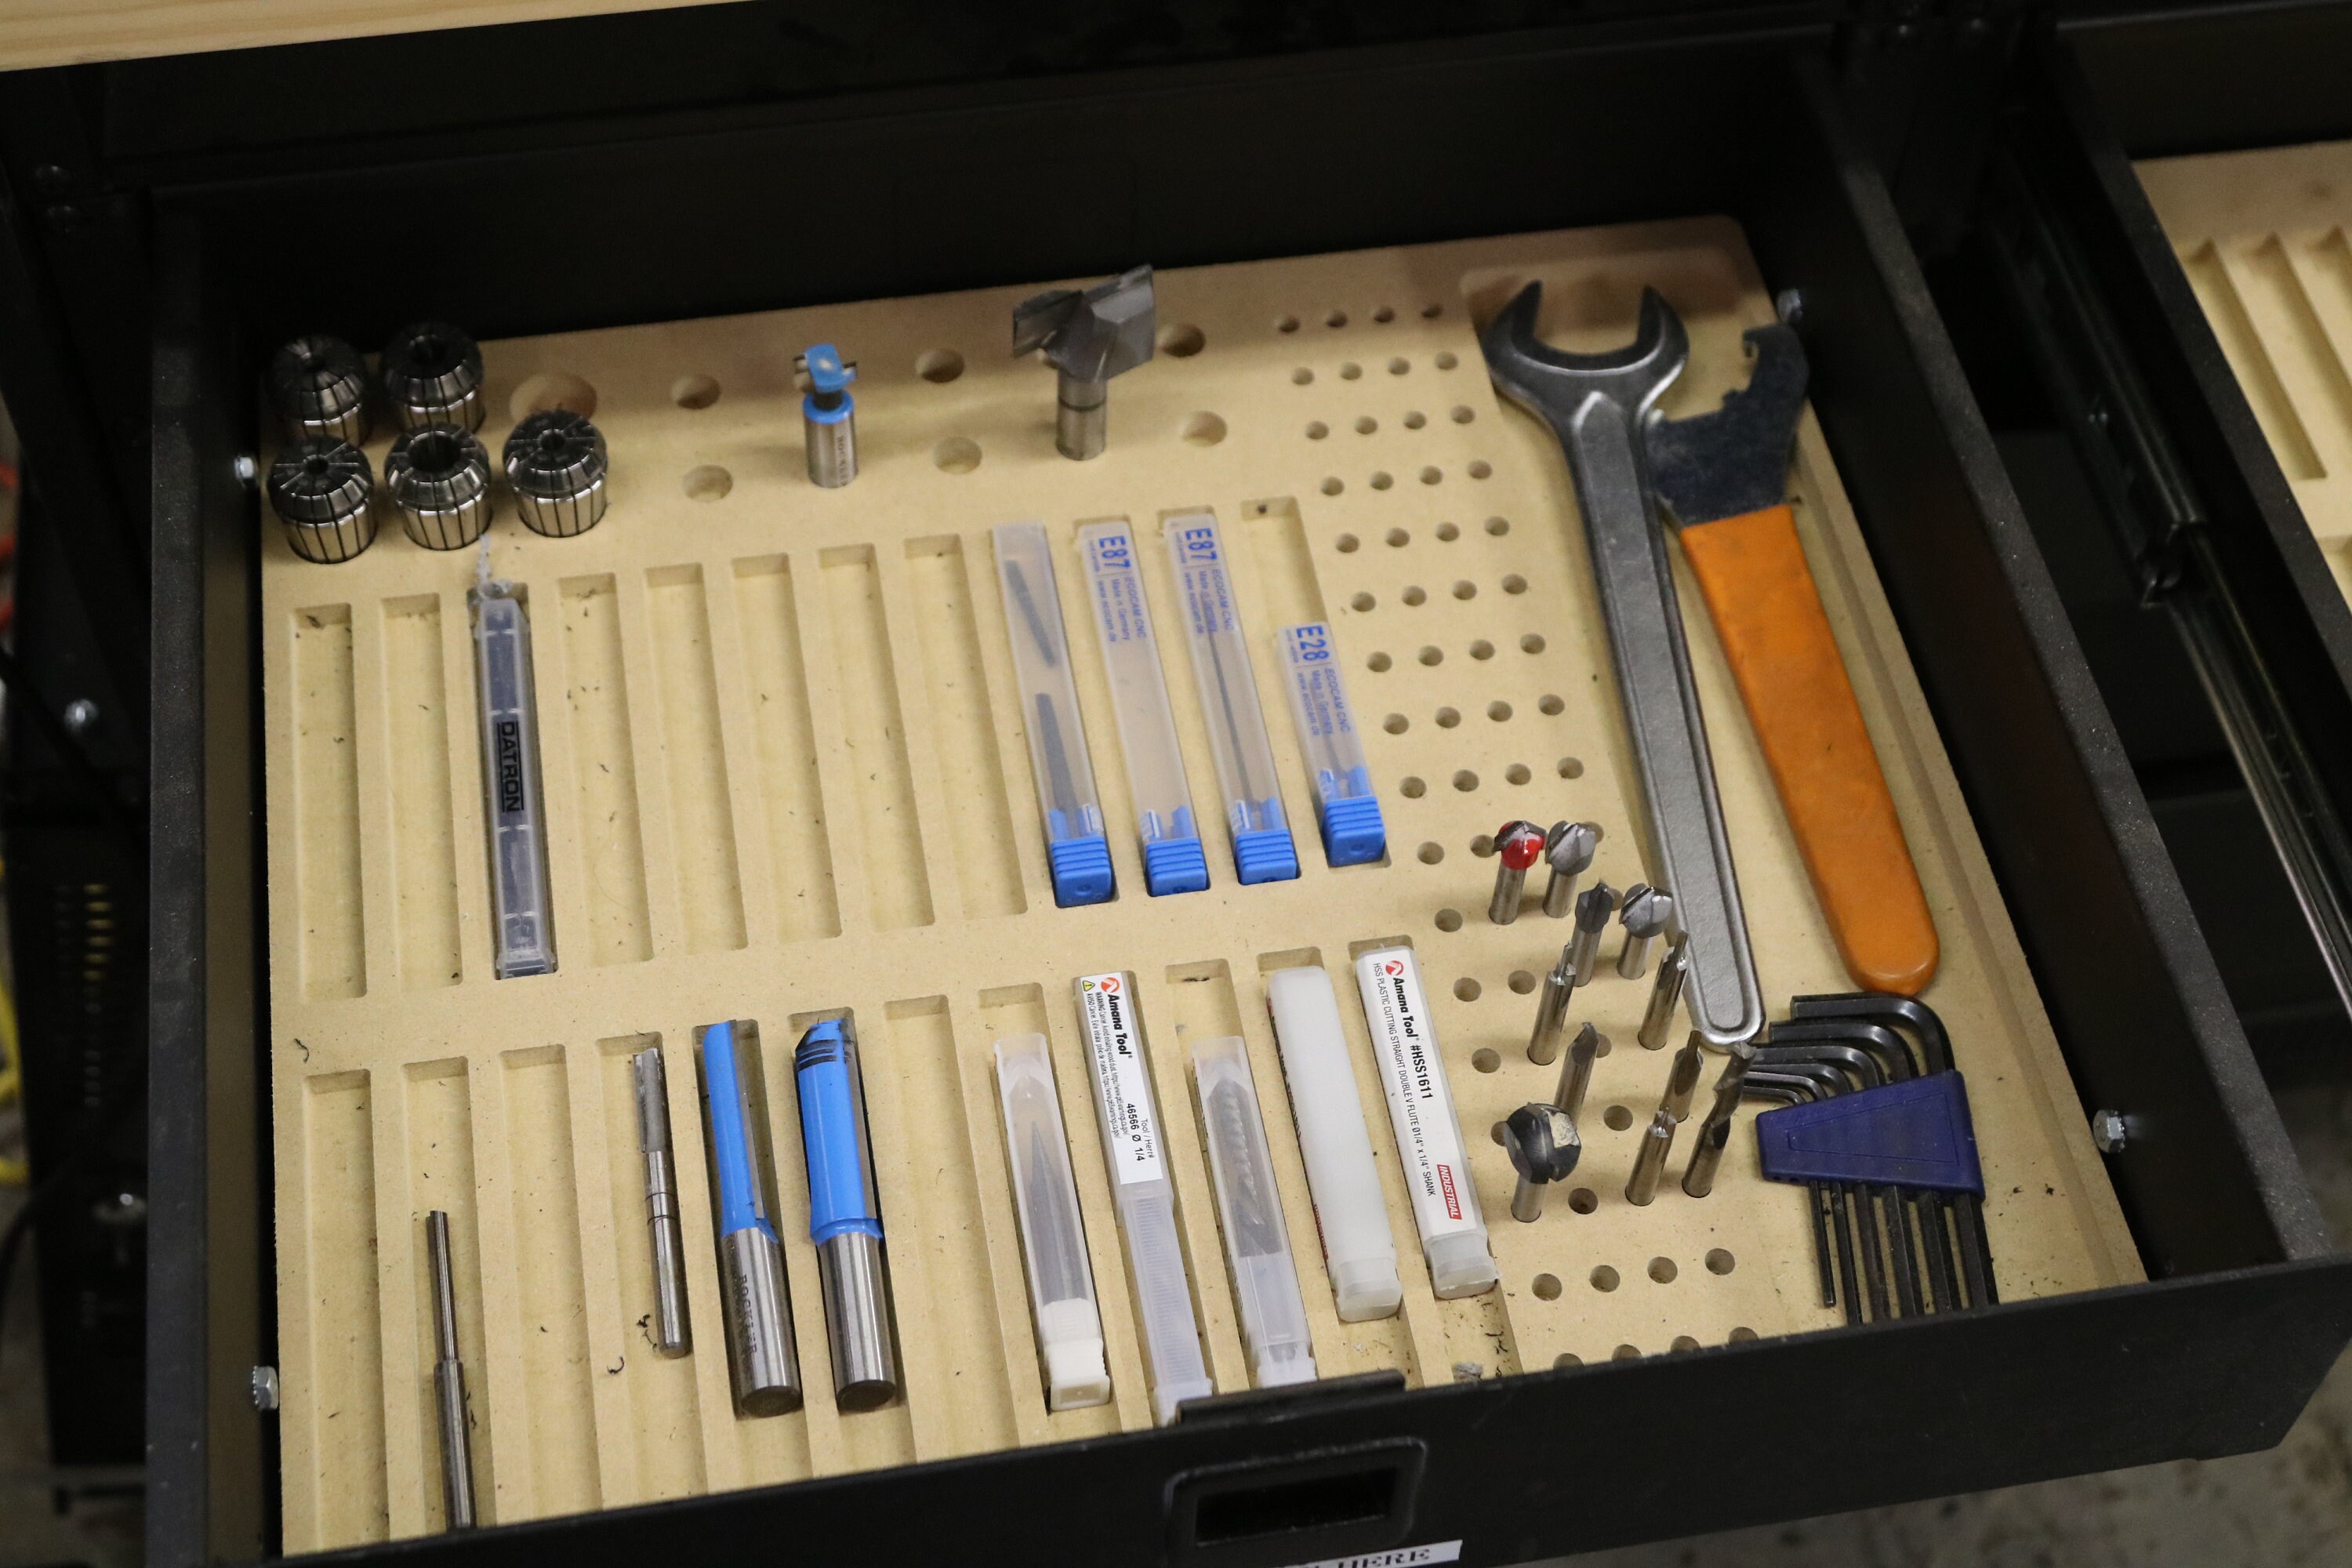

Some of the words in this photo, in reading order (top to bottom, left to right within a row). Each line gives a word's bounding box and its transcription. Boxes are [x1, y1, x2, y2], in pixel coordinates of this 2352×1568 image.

[1098, 535, 1131, 567] E87
[1183, 527, 1218, 560] E87
[1198, 570, 1210, 590] Made
[1111, 578, 1122, 597] Made
[1117, 608, 1131, 640] Germany
[1123, 575, 1142, 615] ECOCAM
[1133, 618, 1147, 638] CNC
[1211, 568, 1229, 608] ECOCAM
[1221, 610, 1235, 631] CNC
[1295, 624, 1330, 659] E28
[1312, 670, 1323, 690] Made
[1318, 701, 1334, 735] Germany
[1324, 667, 1344, 709] ECOCAM
[1335, 711, 1352, 731] CNC
[501, 720, 521, 812] DATRON
[1373, 962, 1384, 977] HSS
[1376, 978, 1390, 1005] PLASTIC
[1107, 994, 1123, 1029] Amana
[1383, 1006, 1397, 1035] CUTTING
[1389, 1036, 1405, 1069] STRAIGHT
[1392, 978, 1407, 1012] Amana
[1410, 1044, 1434, 1098] #HSS1611
[1398, 1070, 1412, 1097] DOUBLE
[1141, 1118, 1150, 1133] Tool
[1406, 1104, 1419, 1126] FLUTE
[1125, 1103, 1139, 1130] 46566
[1134, 1146, 1145, 1161] 1/4
[1421, 1171, 1436, 1196] SHANK
[1439, 1166, 1459, 1218] INDUSTRIAL
[1351, 1548, 1430, 1568] HERE
